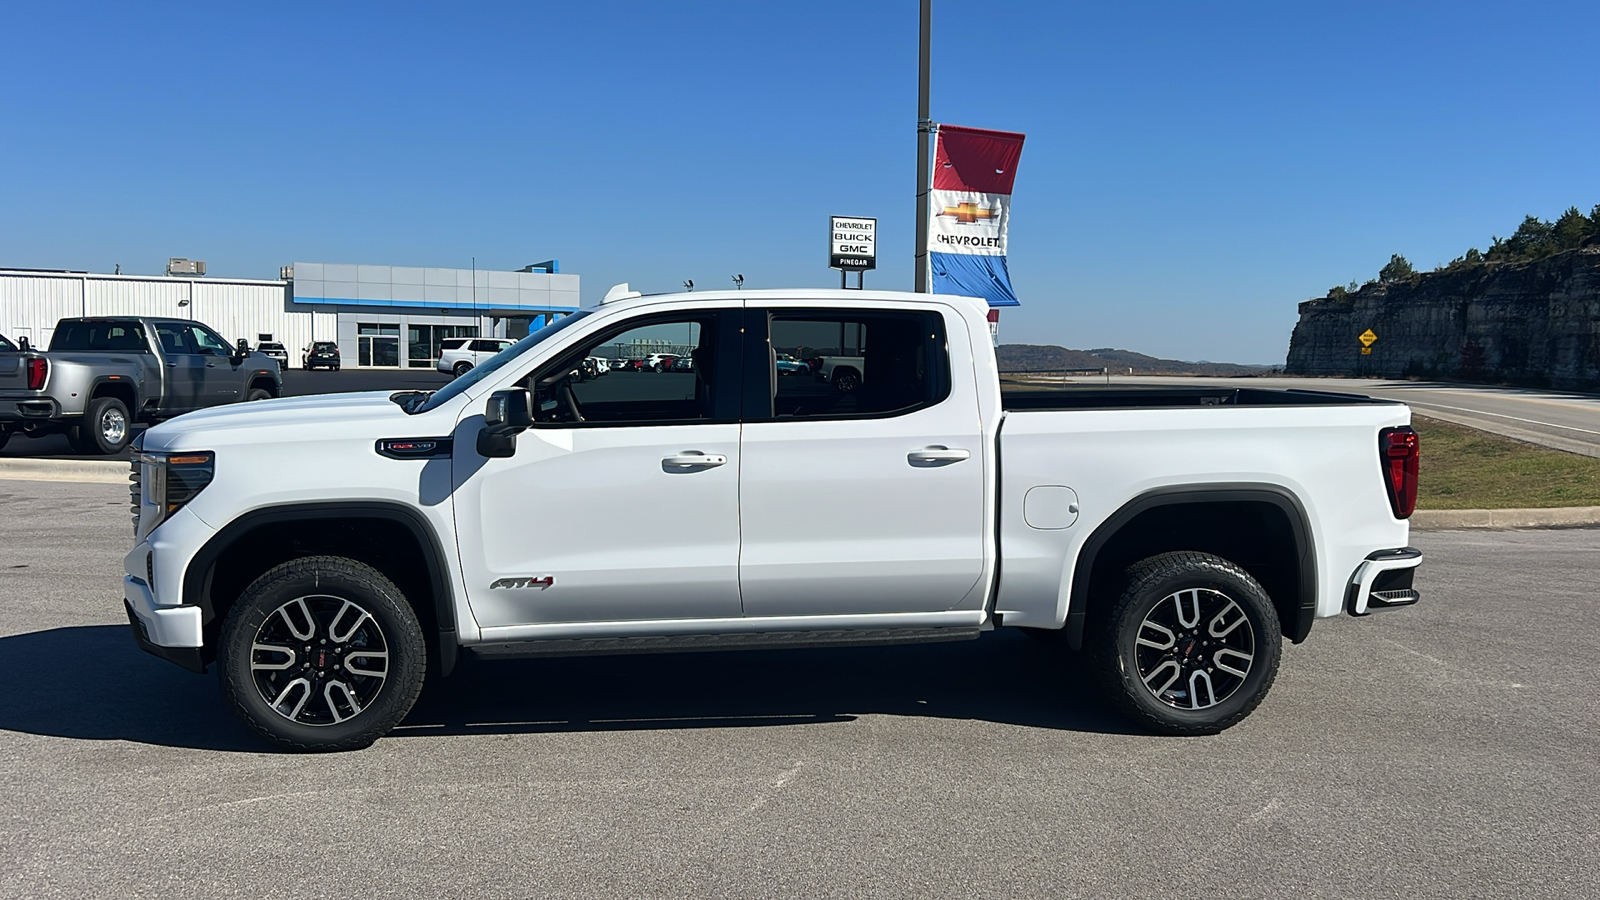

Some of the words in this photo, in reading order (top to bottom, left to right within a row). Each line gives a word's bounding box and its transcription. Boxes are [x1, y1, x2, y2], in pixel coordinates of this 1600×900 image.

[835, 222, 873, 230] CHEVROLET
[834, 233, 873, 242] BUICK
[839, 245, 868, 253] GMC
[840, 258, 868, 266] PINEGAR
[489, 576, 554, 591] AT4
